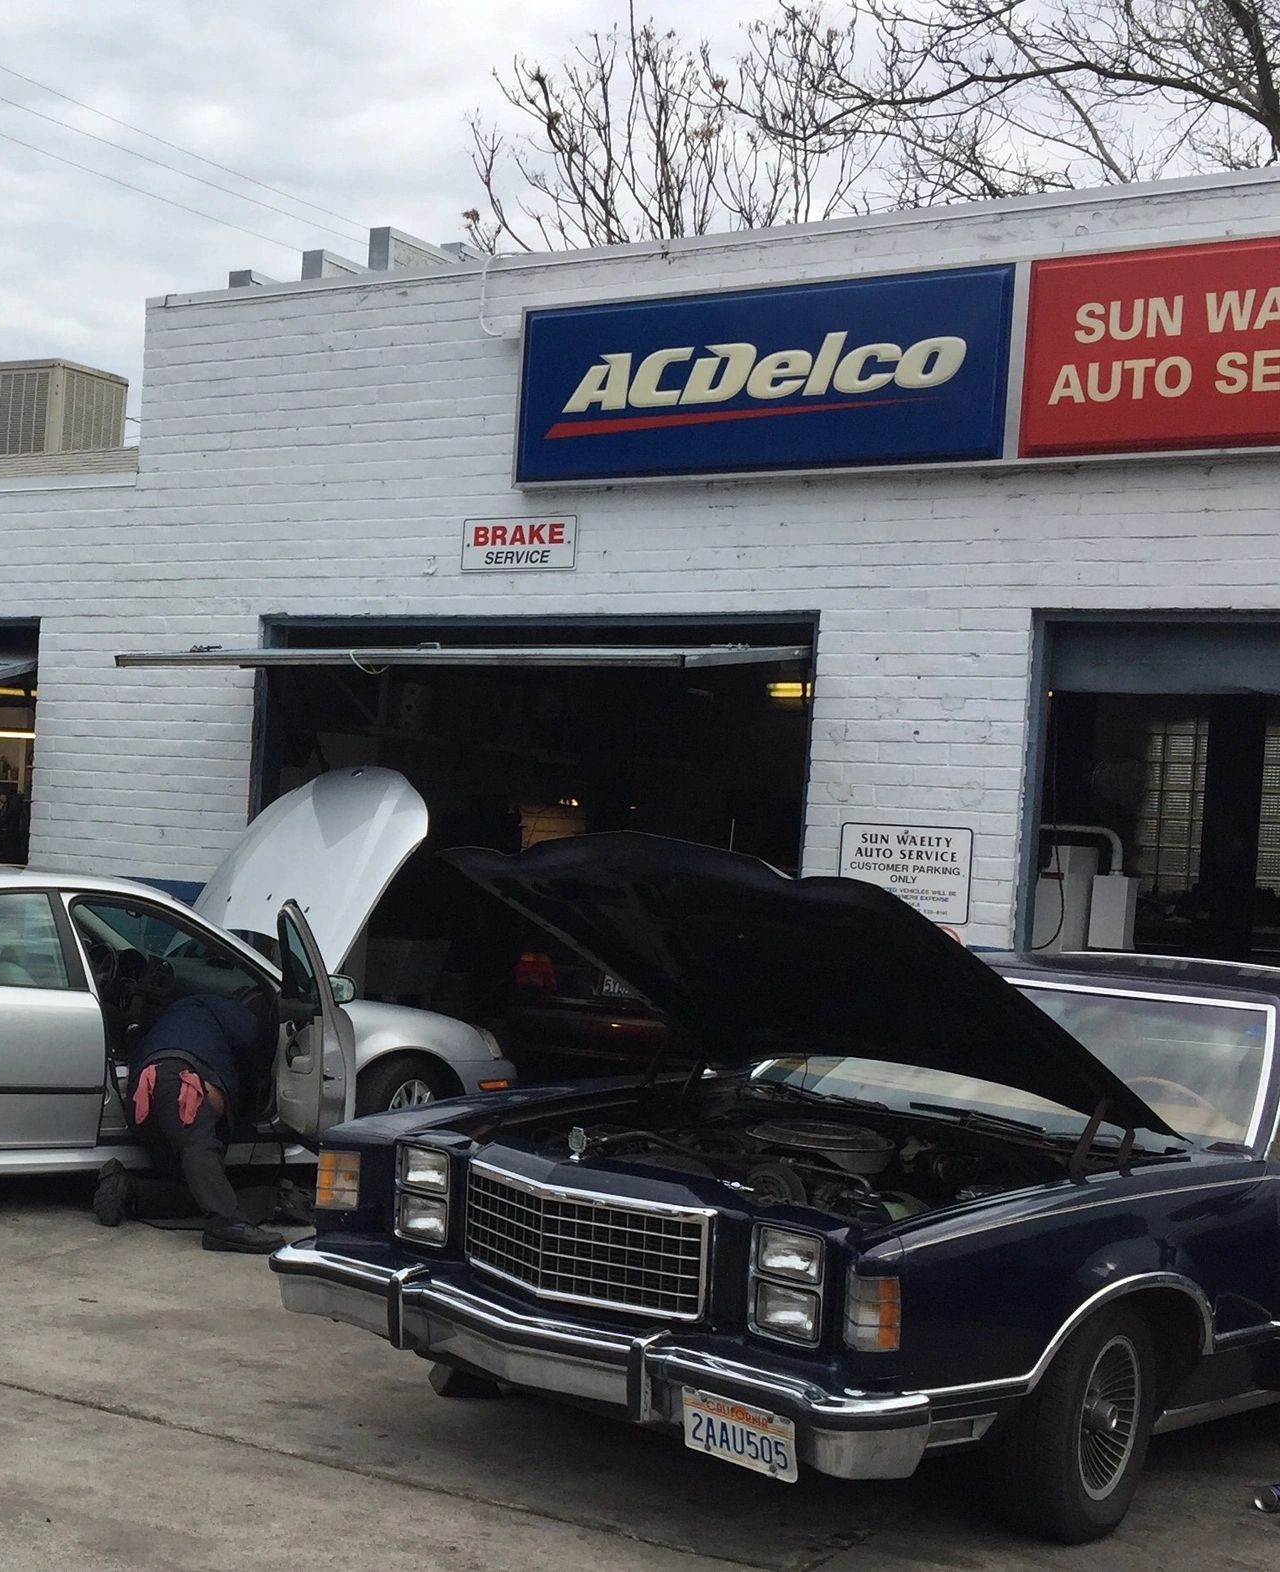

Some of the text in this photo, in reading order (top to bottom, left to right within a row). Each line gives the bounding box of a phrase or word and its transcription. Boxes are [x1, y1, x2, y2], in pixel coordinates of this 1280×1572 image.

[1074, 295, 1184, 344] SUN
[561, 330, 968, 414] ACDelco
[1047, 356, 1193, 405] AUTO
[473, 523, 565, 547] BRAKE
[484, 550, 551, 565] SERVICE
[861, 832, 953, 848] SUN WAELTY
[854, 846, 958, 862] AUTO SERVICE
[850, 861, 961, 876] CUSTOMER PARKING
[889, 874, 918, 884] ONLY
[705, 1400, 768, 1428] CALIFORNIA
[692, 1412, 788, 1470] 2AAU505
